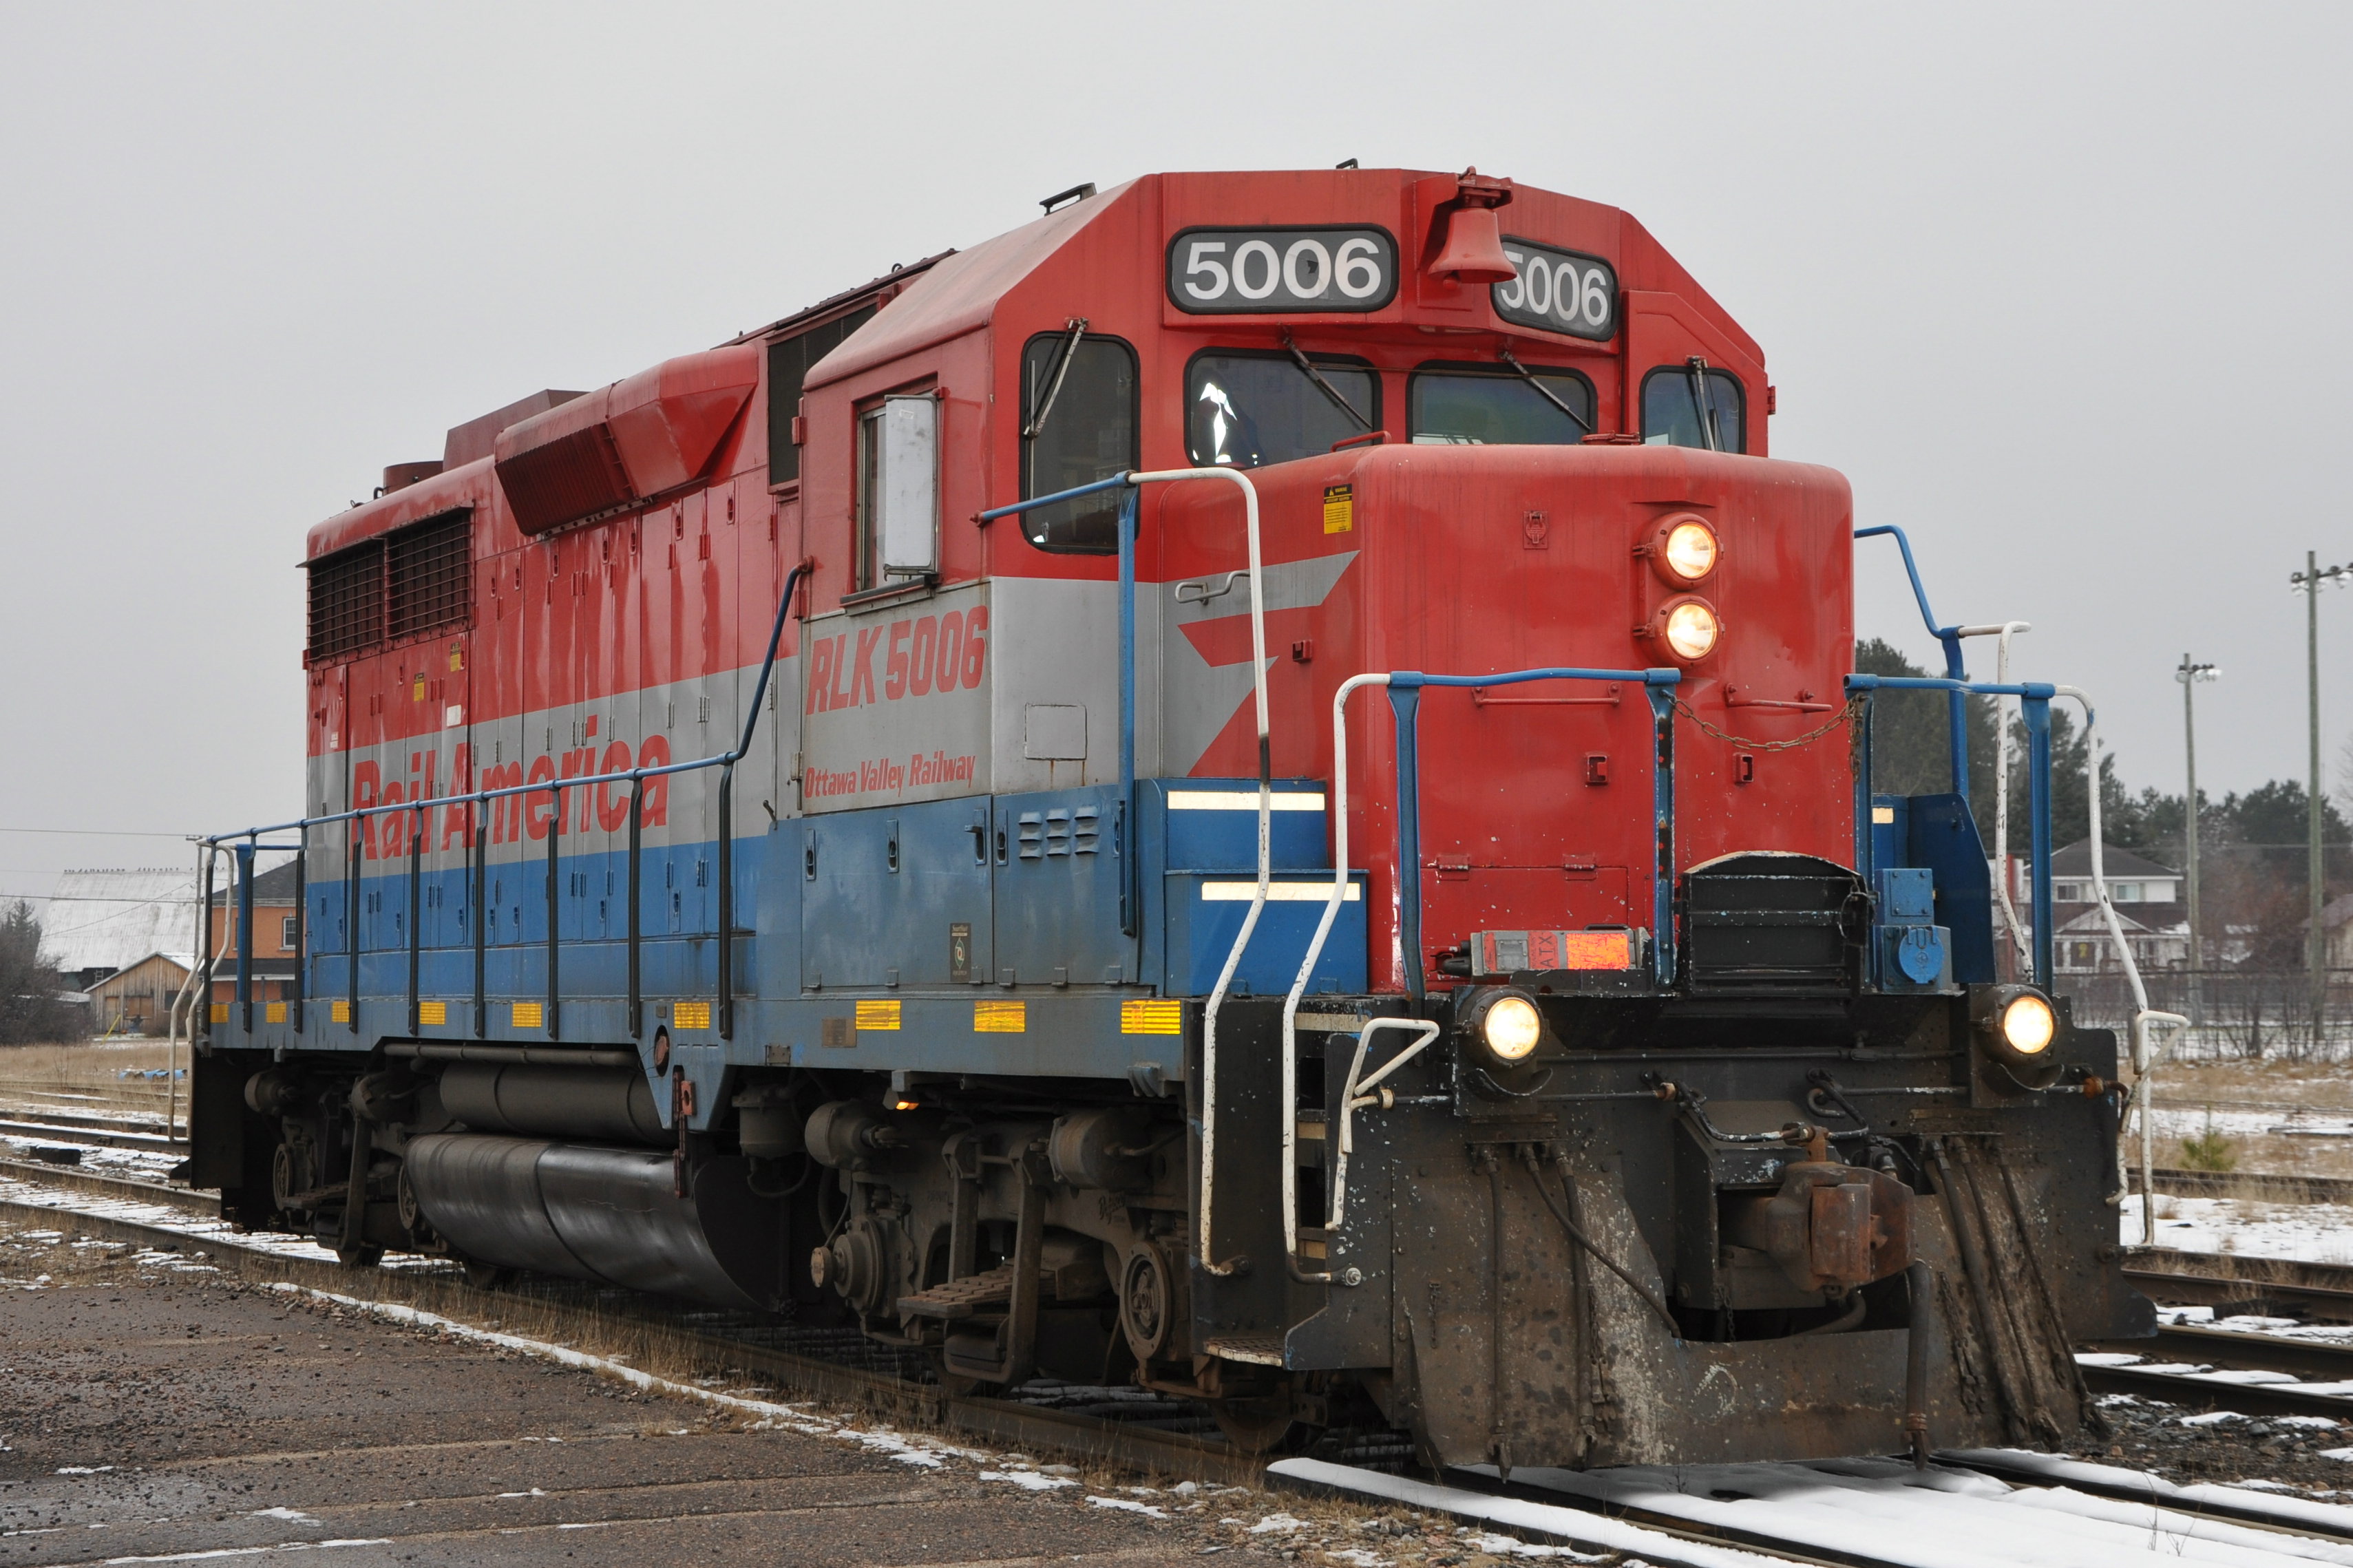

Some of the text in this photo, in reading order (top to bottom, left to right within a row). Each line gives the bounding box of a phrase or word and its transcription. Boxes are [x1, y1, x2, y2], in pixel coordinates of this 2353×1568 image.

[1184, 238, 1381, 300] 5006
[1499, 253, 1609, 326] 5006
[805, 604, 989, 716] RLK 5006
[348, 714, 671, 862] RailAmerica
[804, 750, 975, 798] Ottawa Valley Railway
